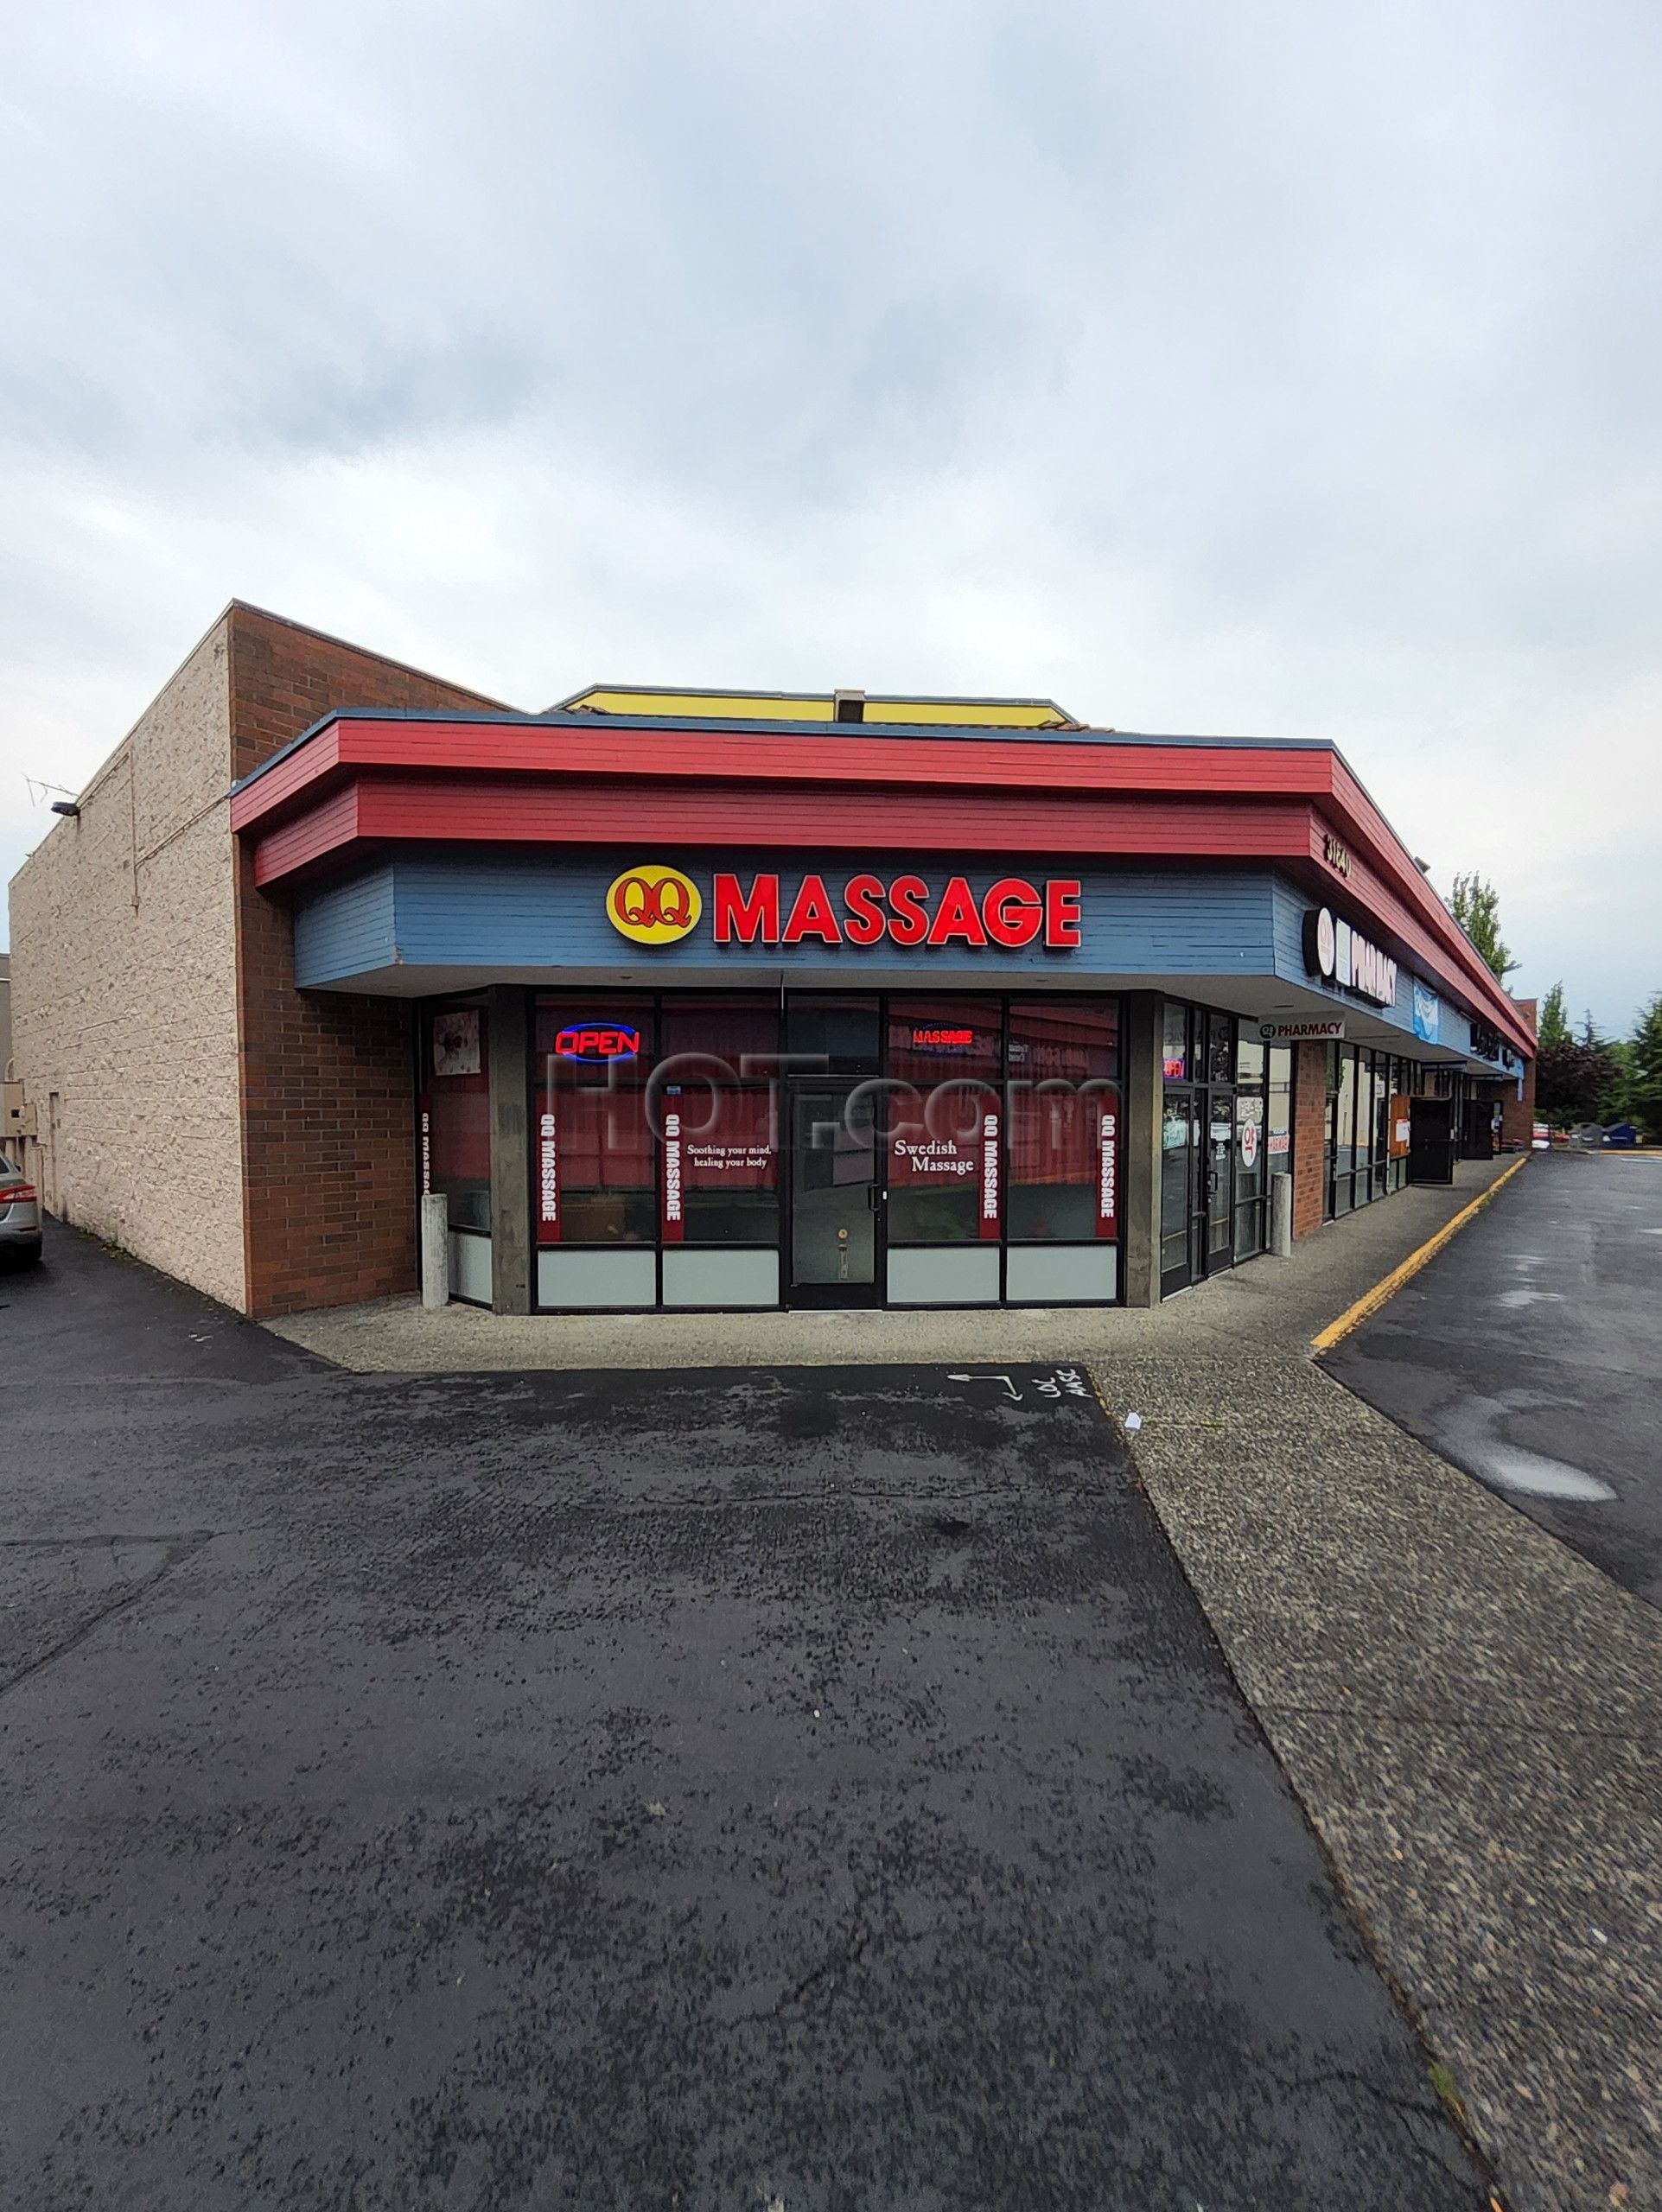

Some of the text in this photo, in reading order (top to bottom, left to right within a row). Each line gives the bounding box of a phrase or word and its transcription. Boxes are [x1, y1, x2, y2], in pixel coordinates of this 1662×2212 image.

[614, 874, 1082, 947] QQ MASSAGE
[913, 1030, 972, 1044] MASSAGE
[1277, 1022, 1342, 1036] PHARMACY
[556, 1032, 640, 1053] OPEN
[422, 1113, 430, 1133] QQ
[687, 1144, 726, 1157] Soothing
[728, 1147, 747, 1157] your
[895, 1140, 958, 1155] Swedish
[540, 1114, 557, 1221] QQ MASSAGE
[665, 1114, 681, 1221] QQ MASSAGE
[694, 1157, 767, 1169] healing your body
[912, 1156, 974, 1175] Massage
[984, 1115, 998, 1219] QQ MASSAGE
[1101, 1115, 1116, 1217] QQ MASSAGE
